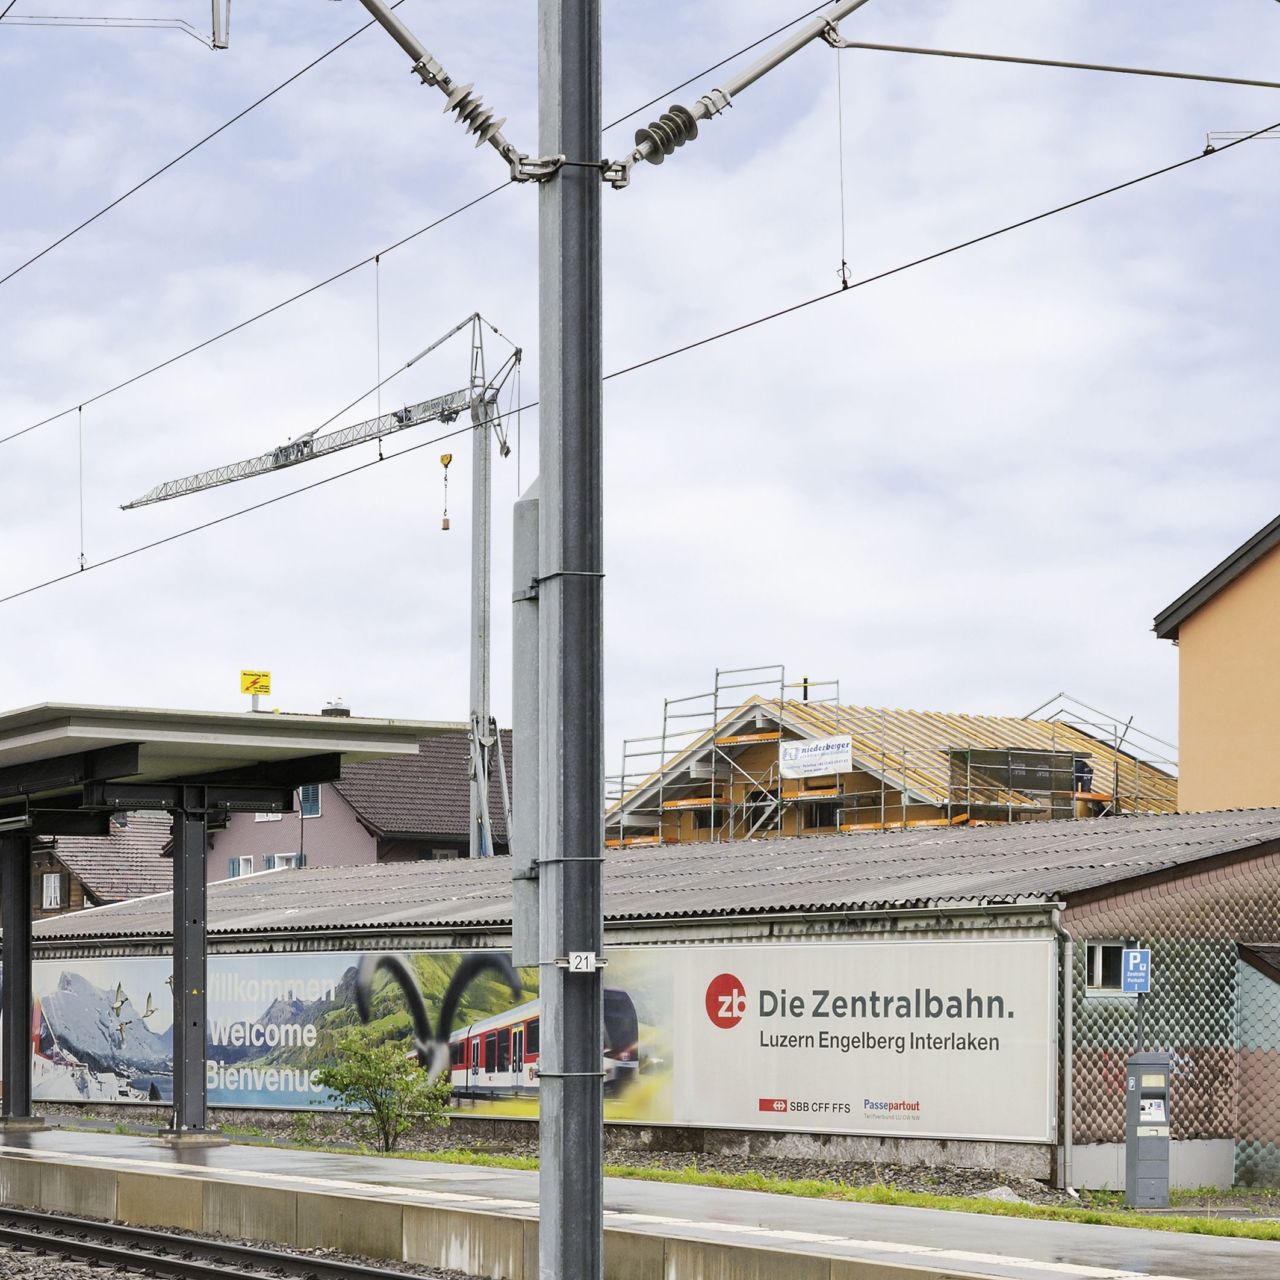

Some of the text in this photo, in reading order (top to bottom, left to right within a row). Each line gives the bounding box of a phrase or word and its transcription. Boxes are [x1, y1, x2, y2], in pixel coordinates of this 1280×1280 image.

[574, 955, 589, 970] 21
[1129, 952, 1141, 971] P
[207, 972, 336, 1001] illkommen
[718, 988, 1014, 1019] zb Die Zentralbahn.
[209, 1019, 317, 1047] Welcome
[760, 1030, 999, 1054] Luzern Engelberg Interlaken
[207, 1060, 325, 1093] Bienvenue
[790, 1101, 851, 1113] SBB CFF FFS
[864, 1099, 920, 1112] Passepartout
